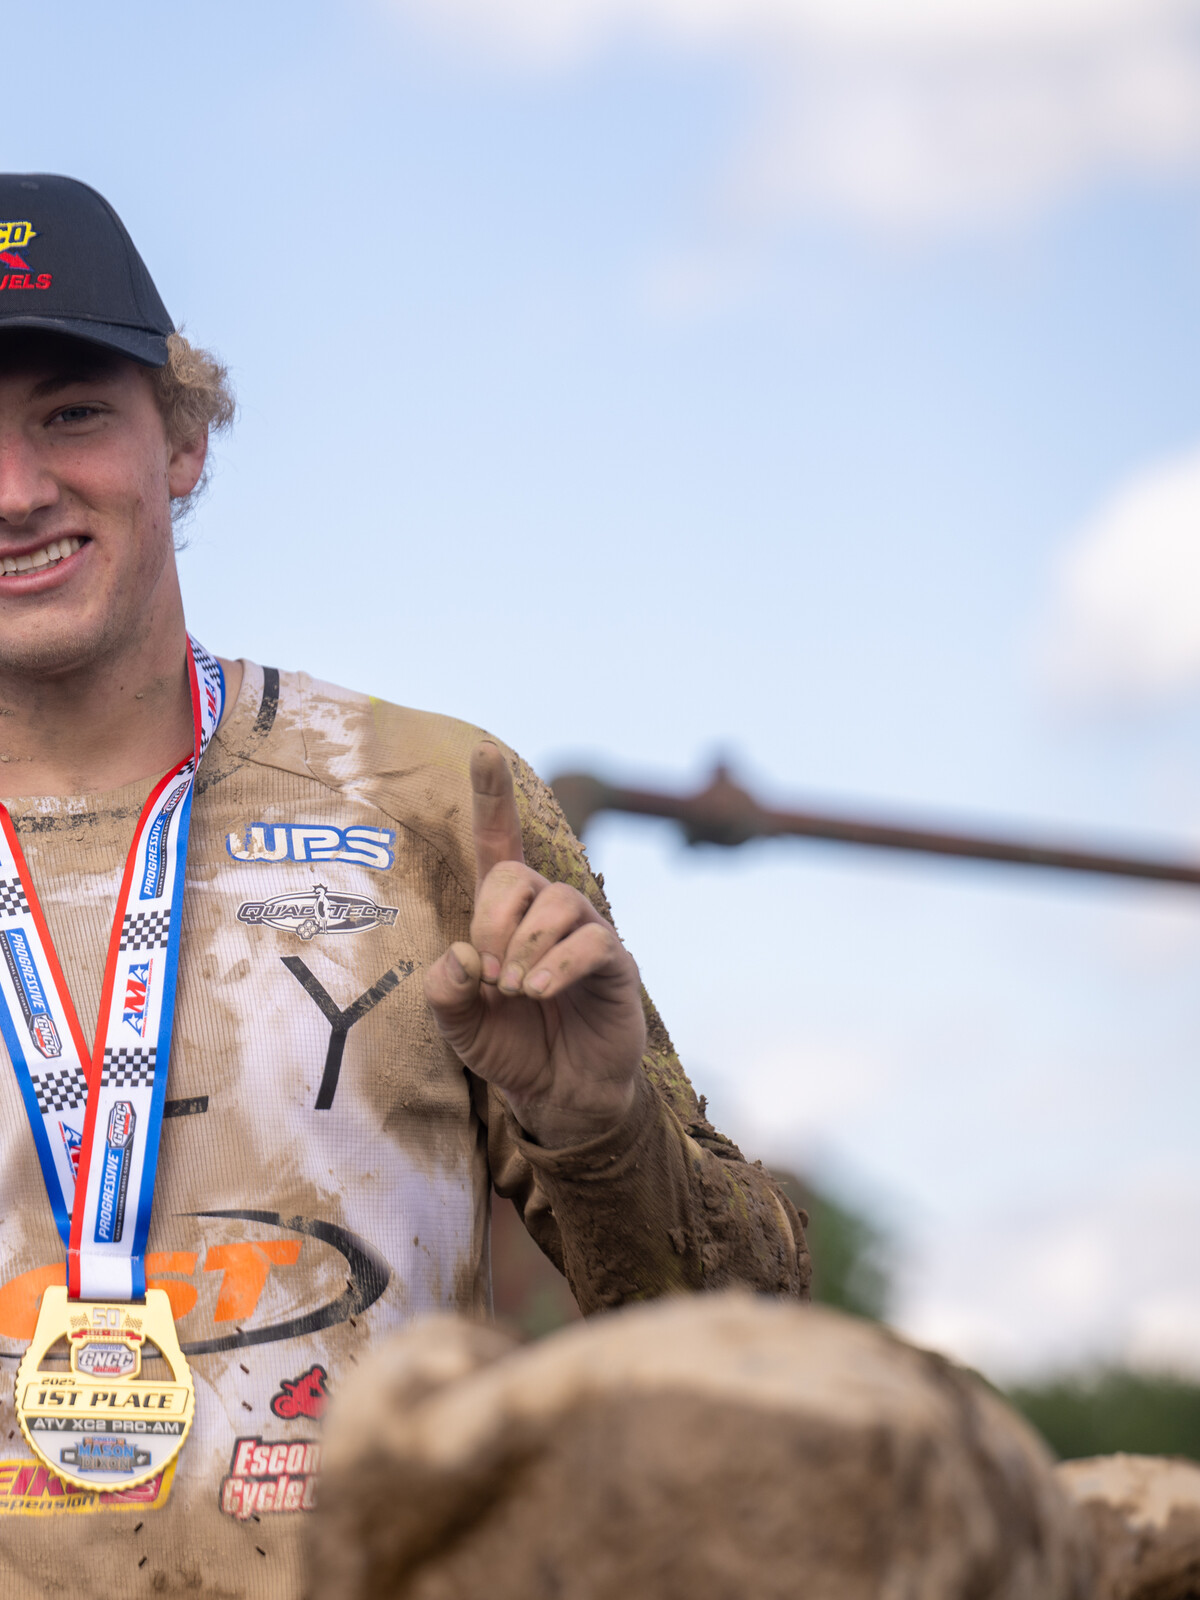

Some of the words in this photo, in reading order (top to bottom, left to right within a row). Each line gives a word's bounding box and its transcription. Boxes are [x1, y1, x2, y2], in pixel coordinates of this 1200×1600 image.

[142, 817, 163, 895] PROGRESSIVE
[228, 825, 392, 870] WPS
[240, 903, 315, 921] QUAD
[327, 904, 398, 925] TECH
[0, 932, 9, 950] GRAND
[5, 950, 16, 975] NATIONAL
[13, 975, 22, 992] CROSS
[18, 992, 29, 1015] COUNTRY
[9, 929, 45, 1011] PROGRESSIVE
[122, 960, 148, 1036] AMA
[35, 1015, 57, 1056] GNCC
[112, 1103, 127, 1144] GNCC
[97, 1152, 119, 1239] PROGRESSIVE
[79, 1351, 134, 1367] GNCC
[38, 1390, 82, 1406] 1ST
[90, 1391, 174, 1409] PLACE
[41, 1378, 75, 1386] 2025
[34, 1420, 67, 1430] ATV
[73, 1420, 106, 1431] XC2
[112, 1421, 180, 1432] PRO-AM
[78, 1445, 135, 1457] MASON
[81, 1457, 131, 1471] DIXON
